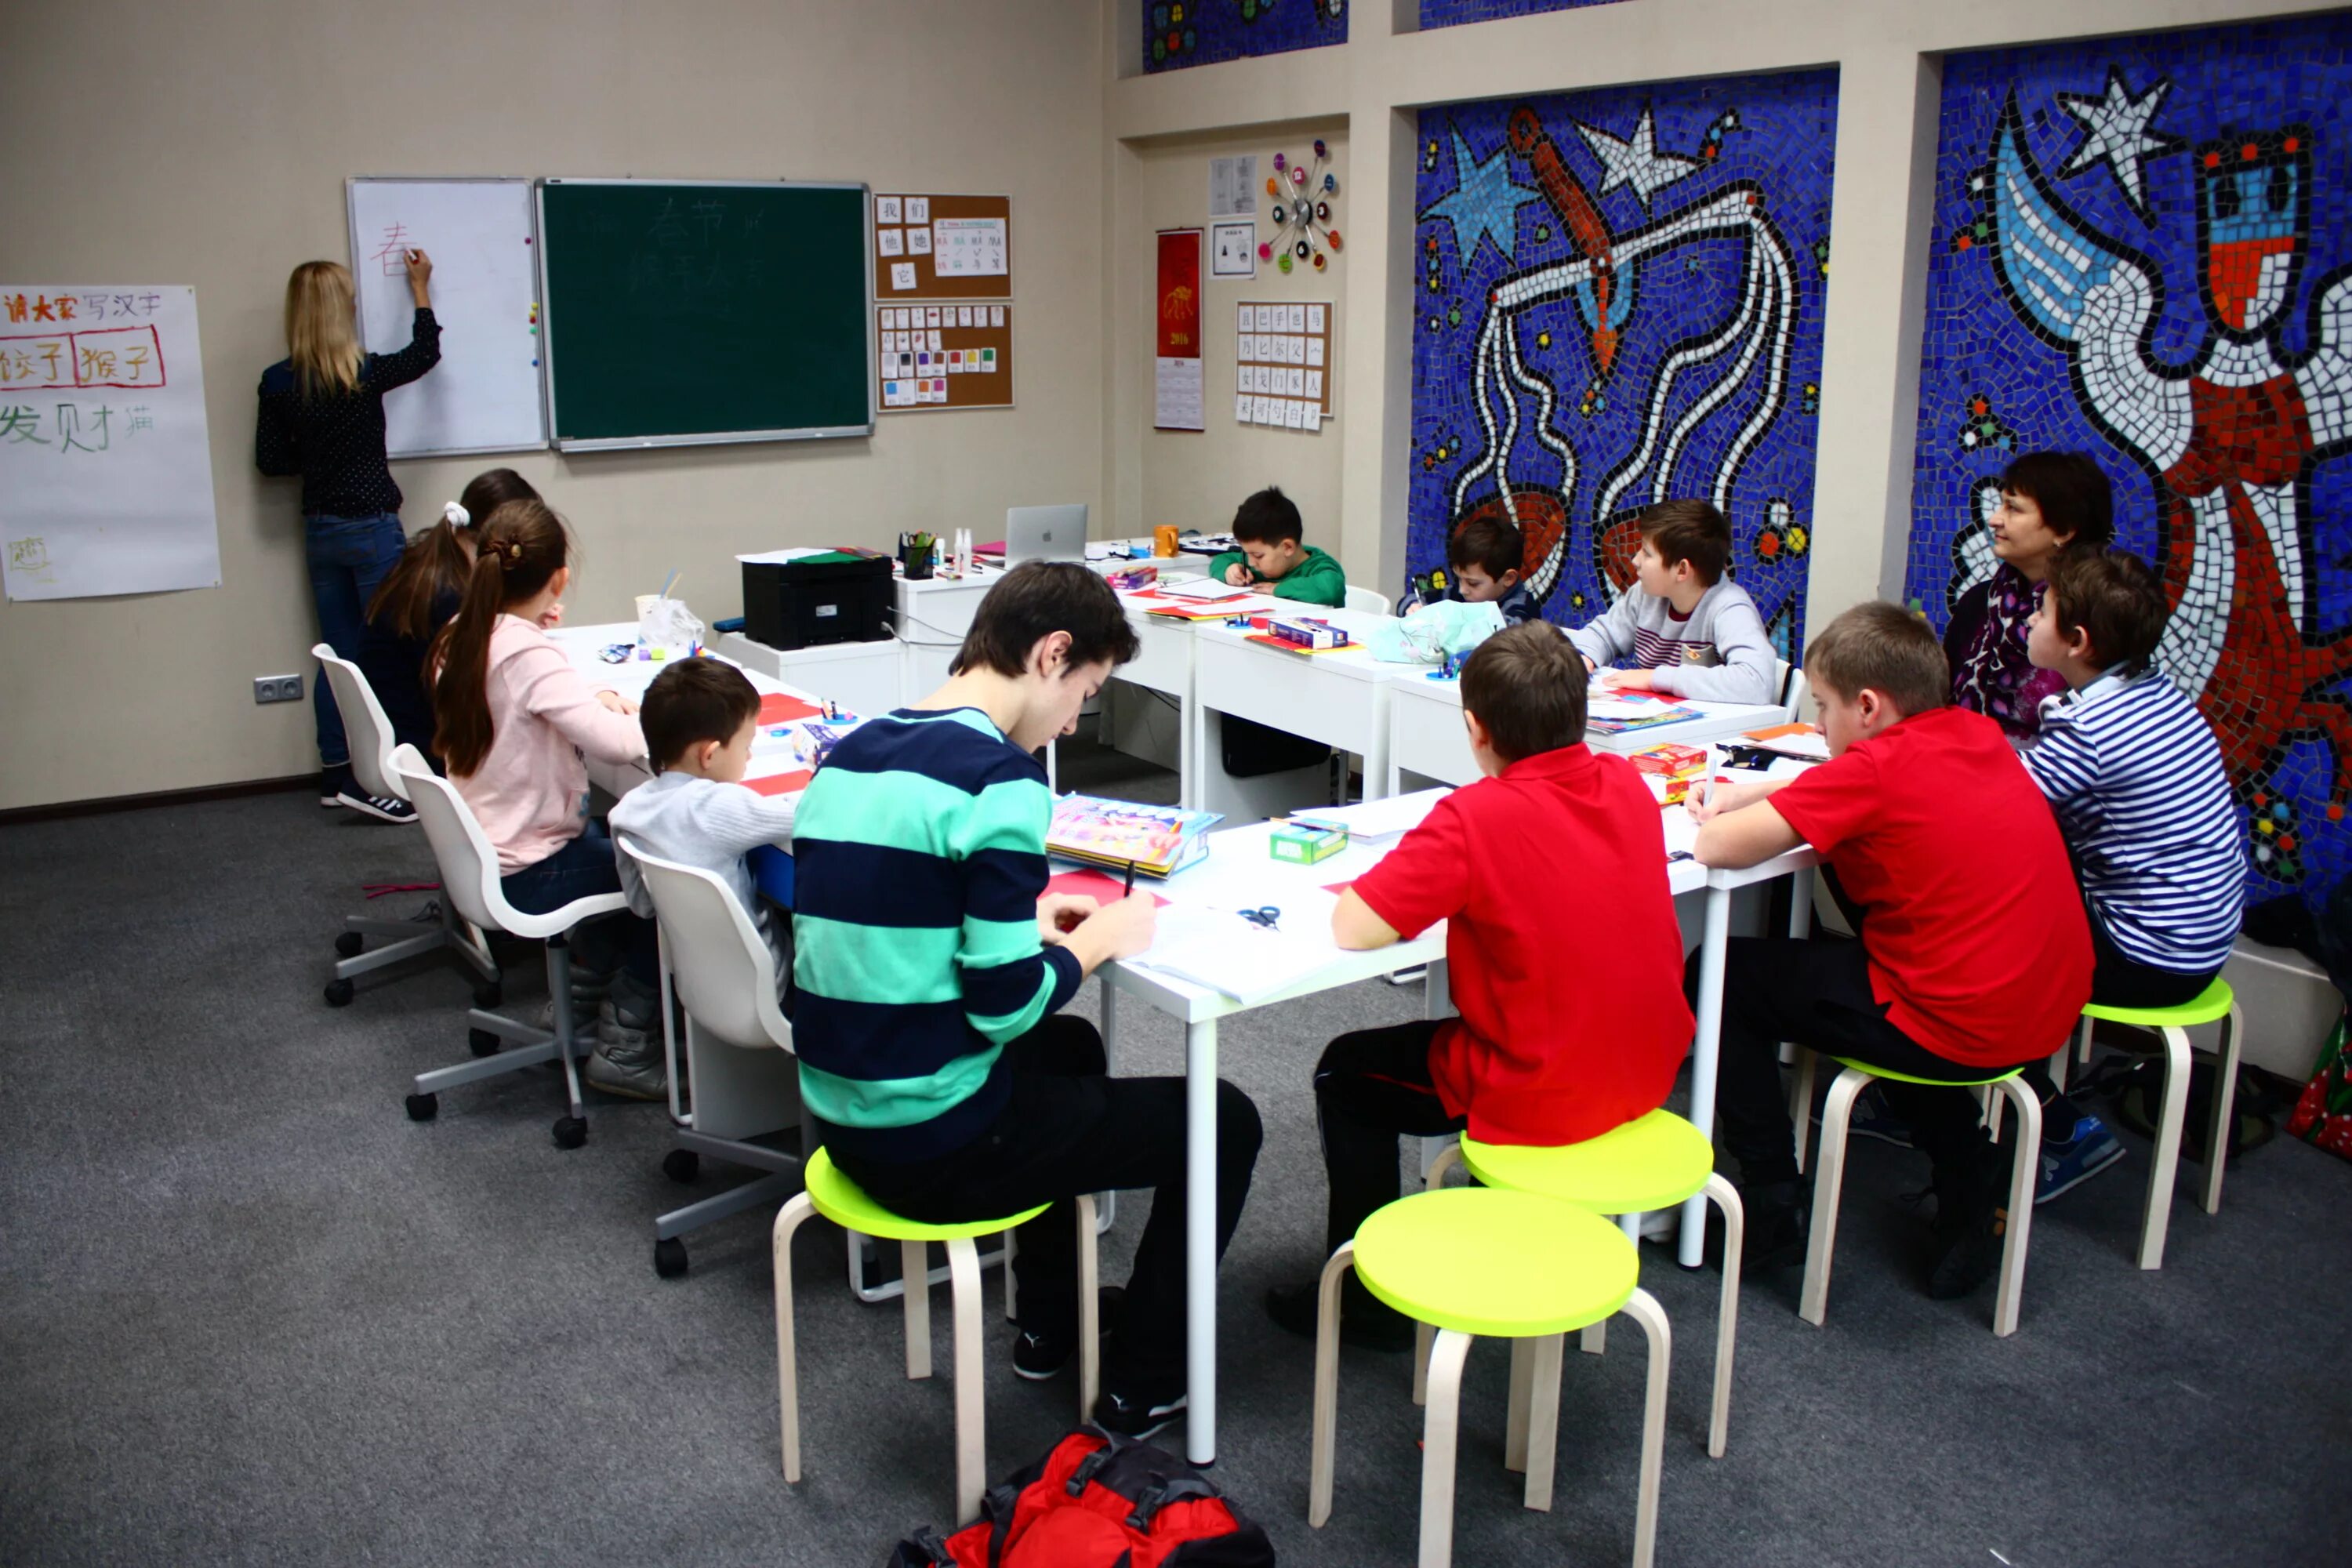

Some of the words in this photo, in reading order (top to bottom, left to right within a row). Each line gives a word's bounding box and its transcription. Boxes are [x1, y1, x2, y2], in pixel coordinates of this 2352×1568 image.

[884, 203, 898, 218] 我
[912, 203, 924, 218] 们
[885, 236, 898, 249] 他
[914, 234, 927, 248] 她
[897, 270, 910, 283] 它
[4, 292, 161, 324] 请大家写汉字
[1171, 332, 1189, 345] 2016
[81, 346, 150, 383] 猴子
